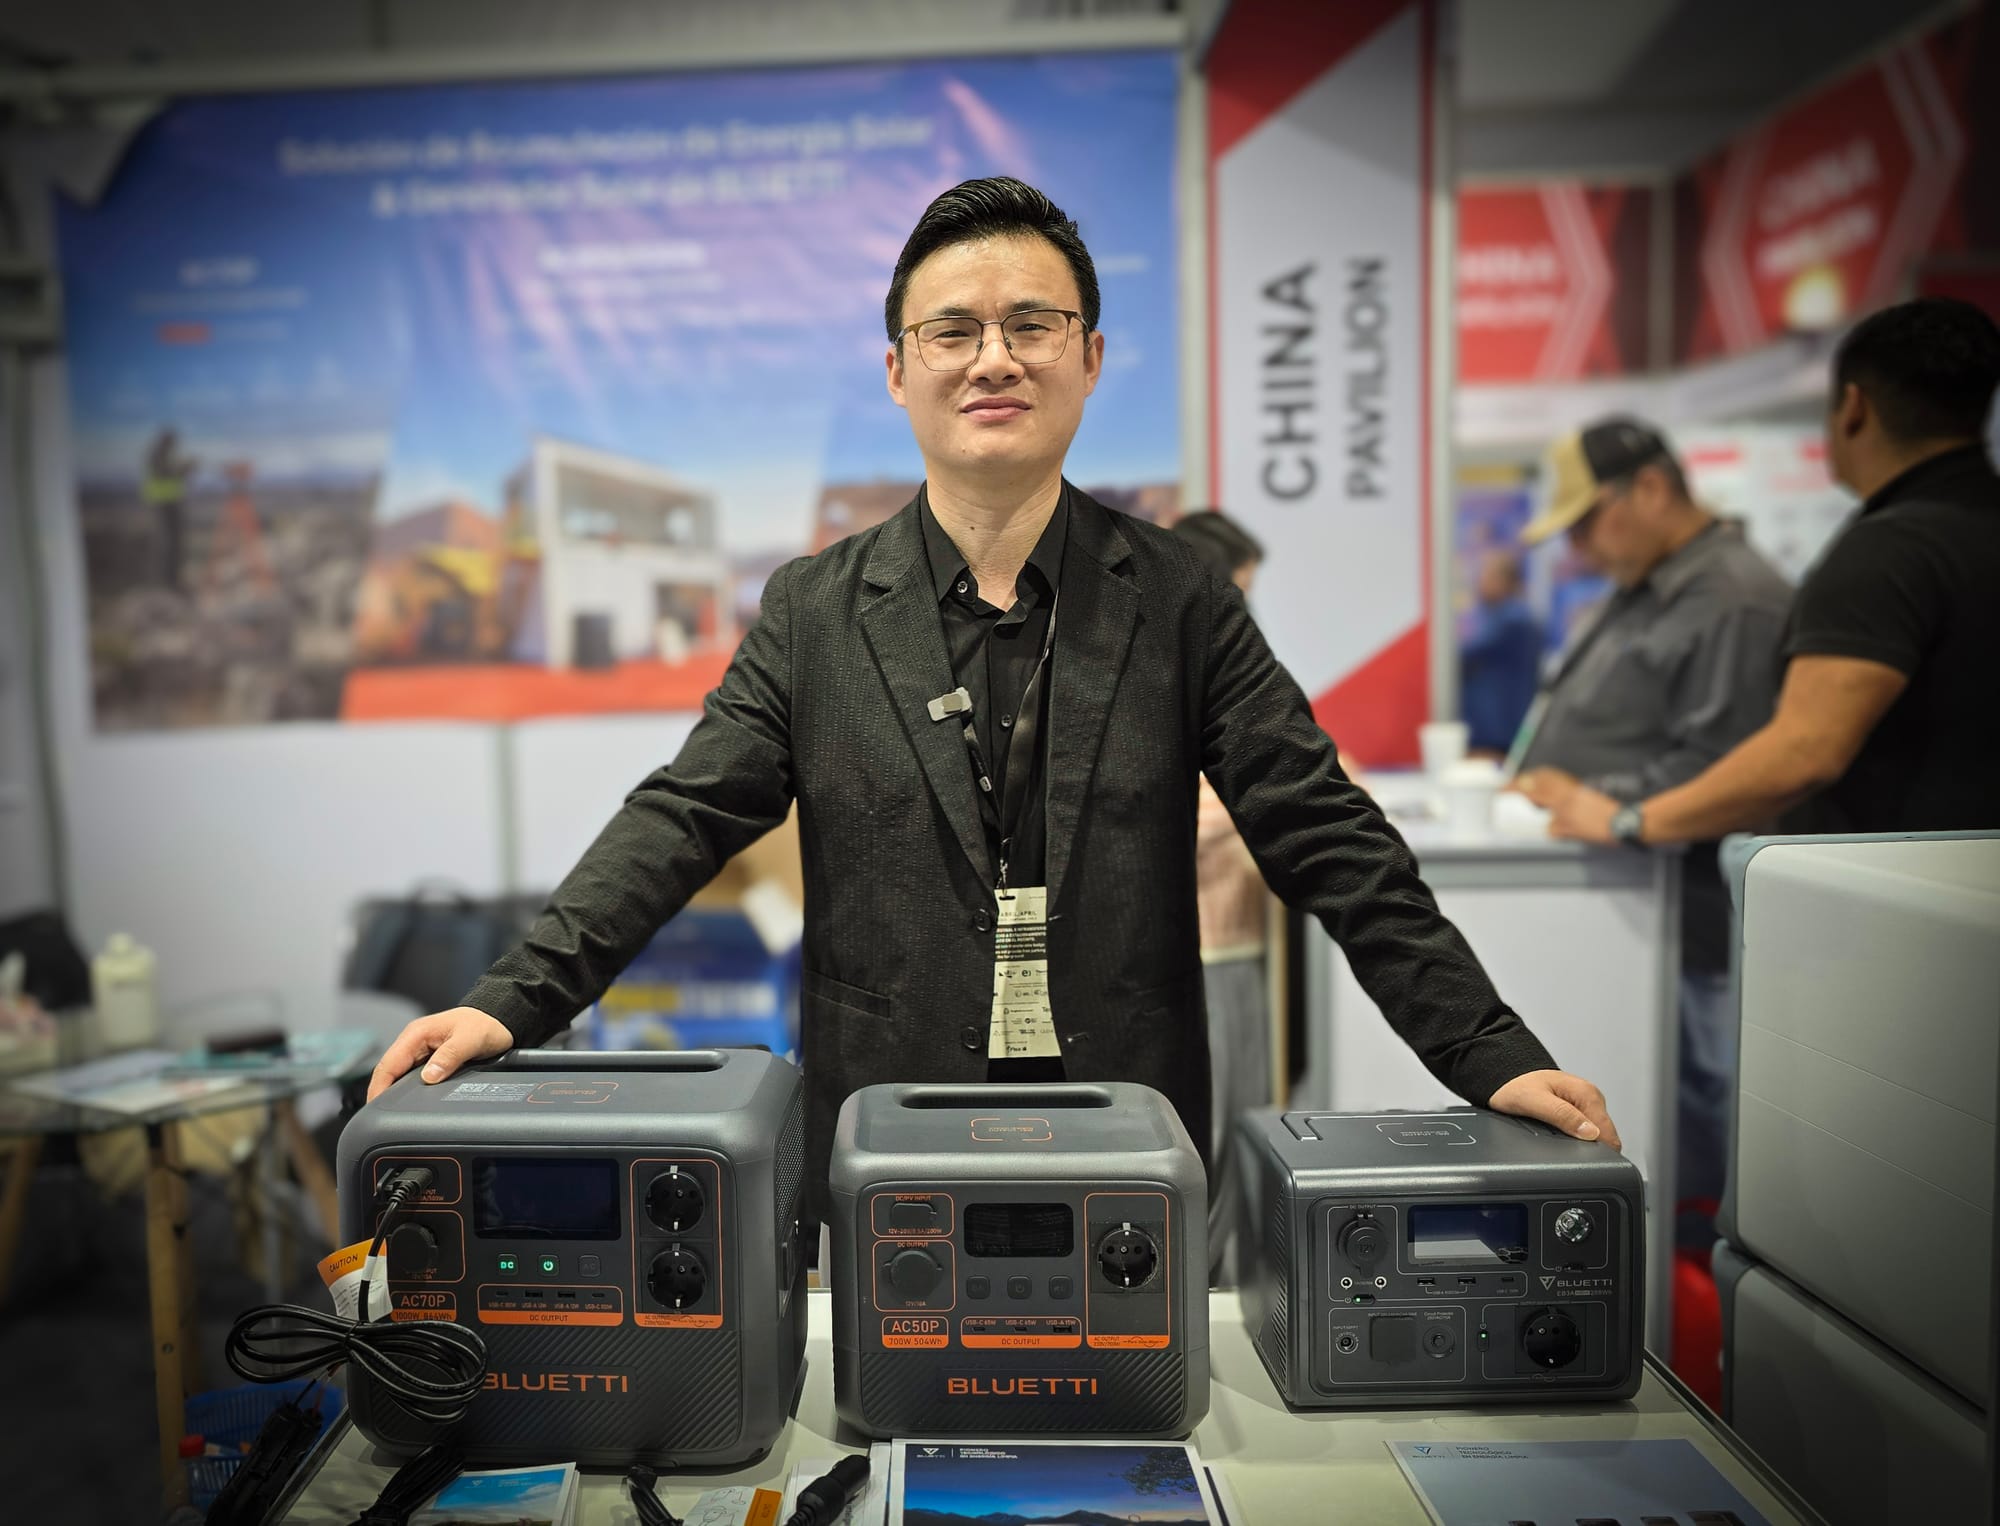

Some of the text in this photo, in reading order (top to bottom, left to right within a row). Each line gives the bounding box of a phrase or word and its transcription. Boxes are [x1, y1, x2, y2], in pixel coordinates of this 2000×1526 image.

[1261, 259, 1319, 500] CHINA
[1345, 255, 1388, 498] PAVILION
[329, 1253, 359, 1273] CAUTION
[500, 1261, 514, 1269] DC
[1556, 1278, 1613, 1288] BLUETTI
[400, 1294, 446, 1308] AC70P
[396, 1311, 419, 1321] 1000W
[891, 1320, 940, 1333] AC50P
[889, 1337, 942, 1345] 700W 504Wh
[480, 1372, 628, 1393] BLUETTI
[948, 1377, 1097, 1395] BLUETTI
